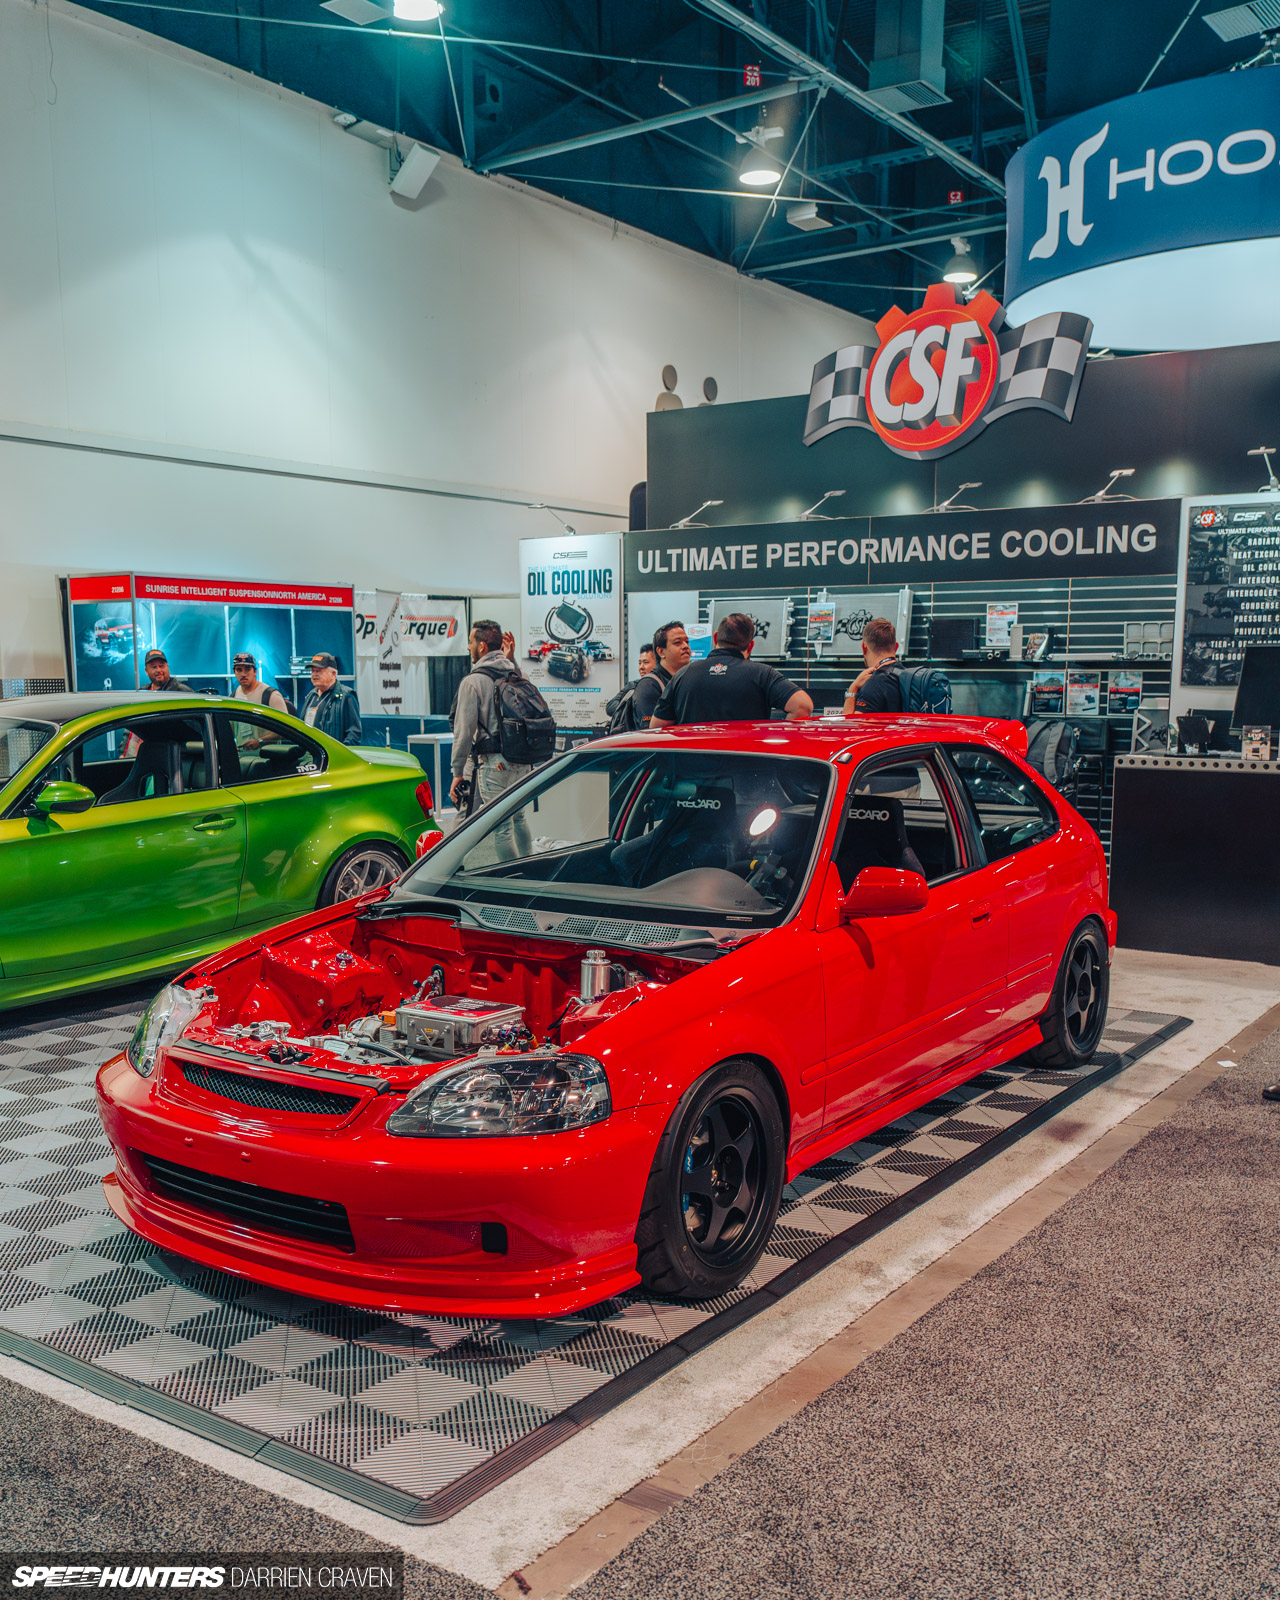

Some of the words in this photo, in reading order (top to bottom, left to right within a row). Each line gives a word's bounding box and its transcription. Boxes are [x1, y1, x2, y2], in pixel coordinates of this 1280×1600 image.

[746, 76, 760, 87] 201
[1109, 129, 1280, 201] HOO
[870, 320, 983, 427] CSF
[1233, 511, 1266, 522] CSF
[637, 544, 758, 574] ULTIMATE
[766, 532, 991, 568] PERFORMANCE
[1000, 523, 1157, 559] COOLING
[1233, 550, 1252, 559] HEAT
[1255, 549, 1280, 559] EXCHA
[540, 564, 569, 573] ULTIMATE
[1242, 563, 1256, 572] OIL
[527, 571, 548, 596] OIL
[551, 568, 613, 596] COOLING
[1238, 575, 1280, 585] INTERCOOL
[145, 583, 180, 595] SUNRISE
[180, 585, 228, 597] INTELLIGENT
[228, 587, 297, 600] SUSPENSIONNORTH
[297, 591, 327, 601] AMERICA
[576, 592, 613, 601] SOLUTIONS
[1226, 588, 1278, 598] INTERCOOLER
[1240, 601, 1280, 610] CONDENSE
[1233, 614, 1273, 623] PRESSURE
[1234, 627, 1266, 636] PRIVATE
[1268, 626, 1280, 635] LA
[1211, 652, 1225, 661] ISO
[676, 798, 722, 810] RECARO
[848, 808, 890, 822] ECARO
